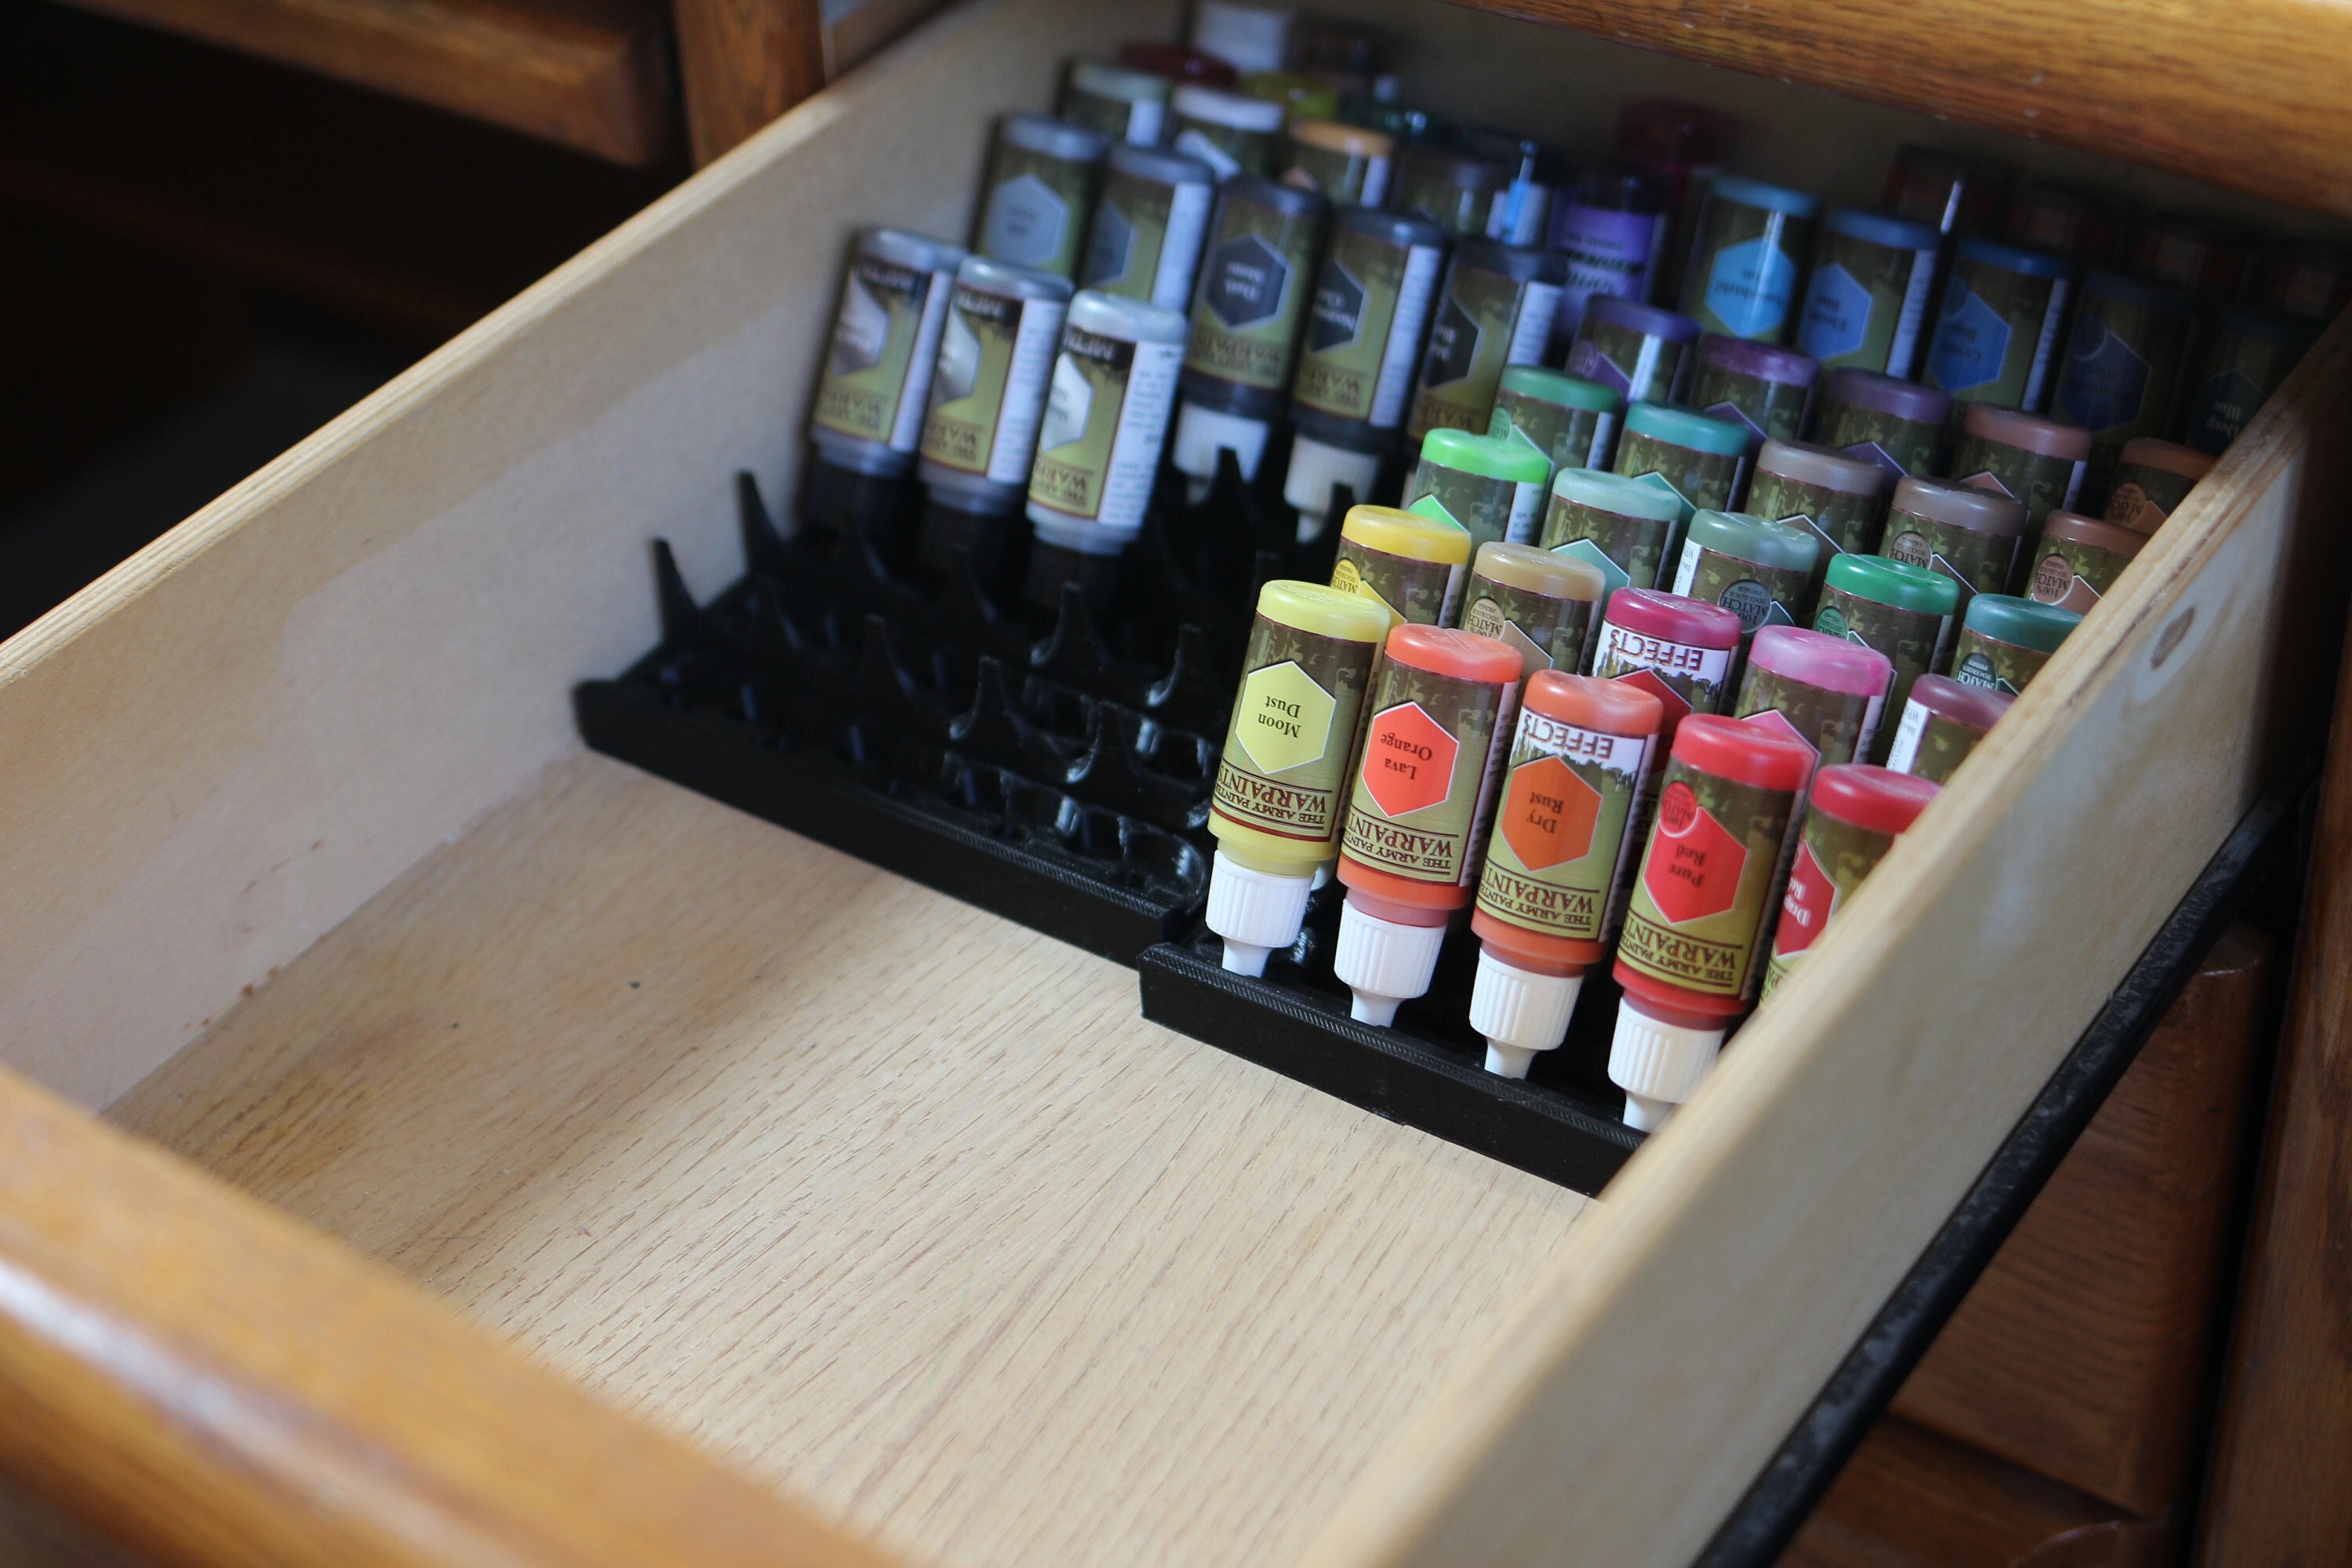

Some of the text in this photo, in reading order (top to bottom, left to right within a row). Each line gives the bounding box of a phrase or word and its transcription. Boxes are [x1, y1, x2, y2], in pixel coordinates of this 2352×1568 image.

[2212, 400, 2242, 419] Blue
[2205, 416, 2239, 439] Deep
[1891, 548, 1929, 568] MATCH
[2035, 573, 2070, 590] MATCH
[2036, 583, 2059, 598] 100%
[1721, 597, 1768, 616] MATCH
[1468, 614, 1501, 635] MATCH
[1609, 630, 1704, 671] EFFECTS
[1265, 695, 1301, 718] Dust
[1257, 713, 1301, 738] Moon
[1380, 733, 1432, 760] Orange
[1522, 714, 1614, 759] EFFECTS
[1384, 758, 1417, 779] Lava
[1251, 803, 1296, 820] ARMY
[1529, 792, 1564, 815] Rust
[1299, 813, 1324, 824] THE
[1526, 812, 1558, 833] Dry
[1344, 831, 1451, 869] THE ARMY PAINTE
[1675, 844, 1706, 866] Red
[1667, 864, 1704, 888] Pure
[1479, 886, 1592, 925] THE ARMY PAINTE
[1783, 896, 1810, 927] Drag
[1656, 956, 1702, 975] ARMY
[1704, 969, 1733, 981] THE
